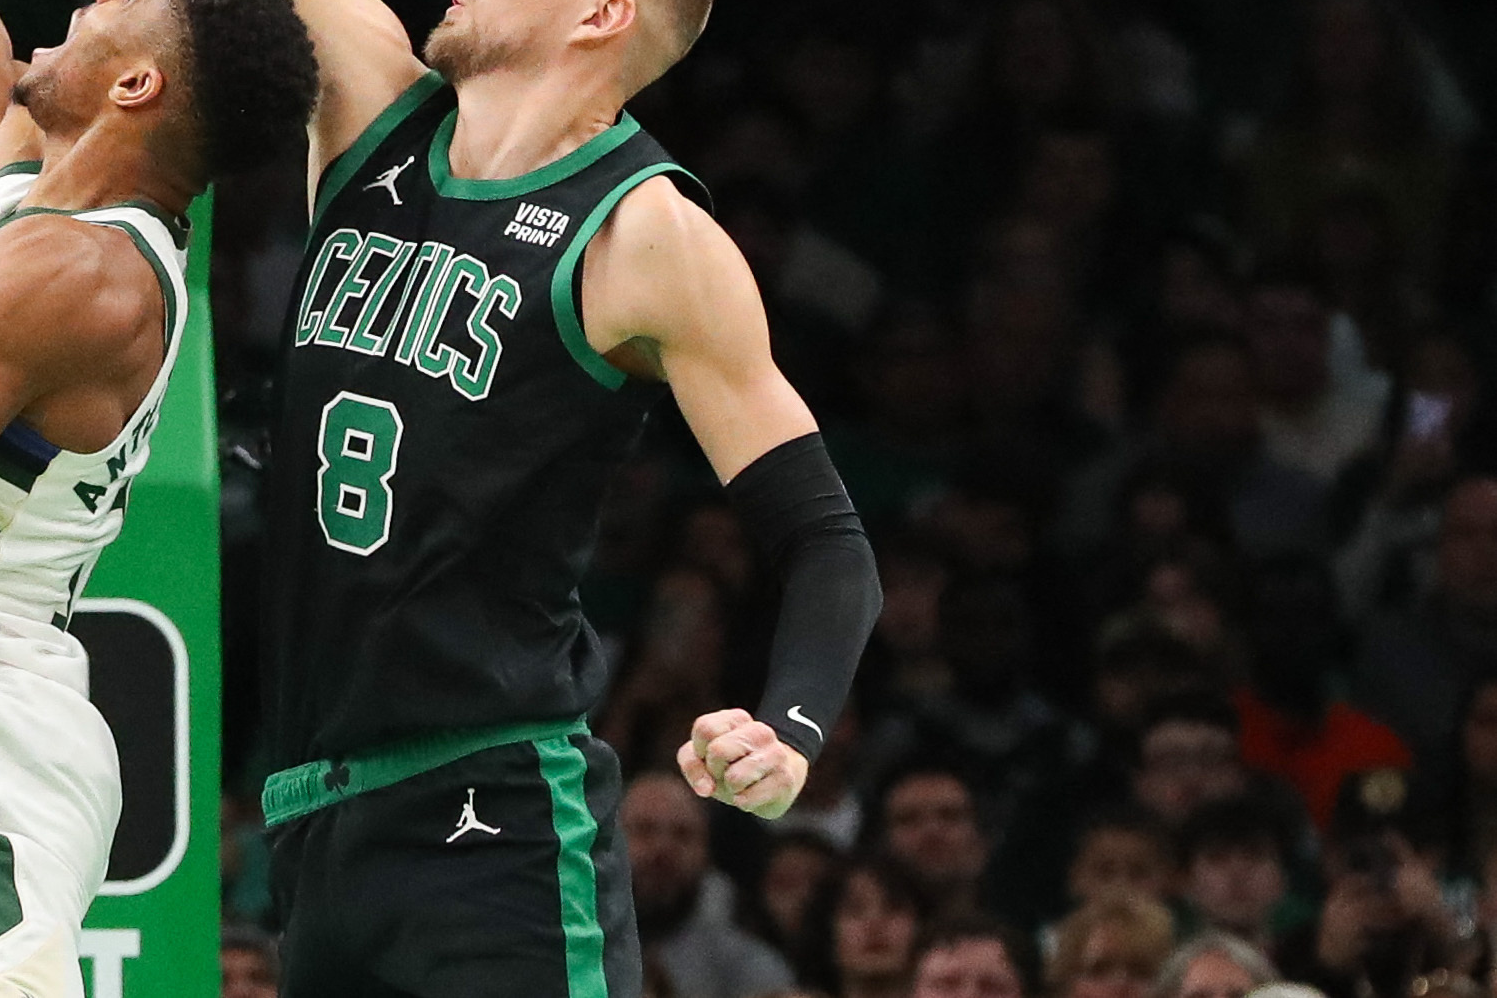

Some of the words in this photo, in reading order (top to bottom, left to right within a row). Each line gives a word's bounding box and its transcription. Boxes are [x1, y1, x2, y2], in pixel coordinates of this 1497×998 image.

[504, 220, 561, 248] PRINT
[515, 202, 570, 235] VISTA
[317, 390, 404, 556] 8
